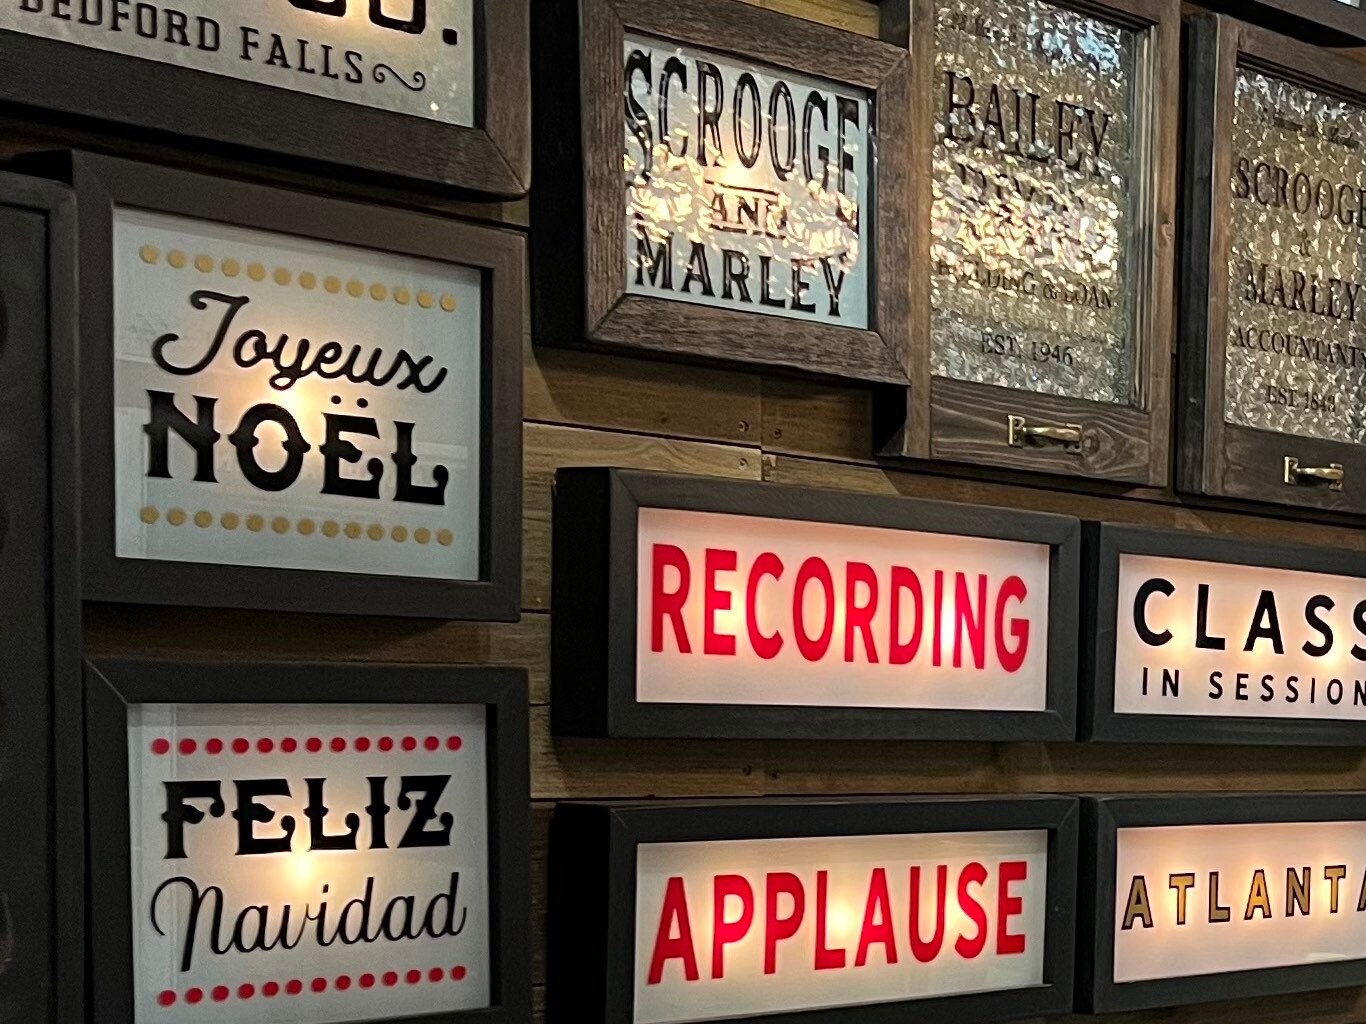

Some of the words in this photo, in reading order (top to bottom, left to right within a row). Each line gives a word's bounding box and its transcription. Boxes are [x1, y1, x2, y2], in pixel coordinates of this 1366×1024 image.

[240, 26, 363, 84] FALLS
[625, 49, 861, 240] SCROOGE
[942, 70, 1113, 177] BAILEY
[709, 191, 789, 232] AND
[634, 224, 850, 318] MARLEY
[1244, 263, 1361, 322] MARLEY
[152, 289, 448, 394] Joyeux
[1031, 340, 1074, 366] 1946
[143, 388, 450, 506] NOËL
[651, 542, 1030, 673] RECORDING
[1141, 666, 1180, 698] IN
[160, 774, 455, 860] FELIZ
[150, 871, 468, 972] Navidad
[646, 860, 1028, 985] APPLAUSE
